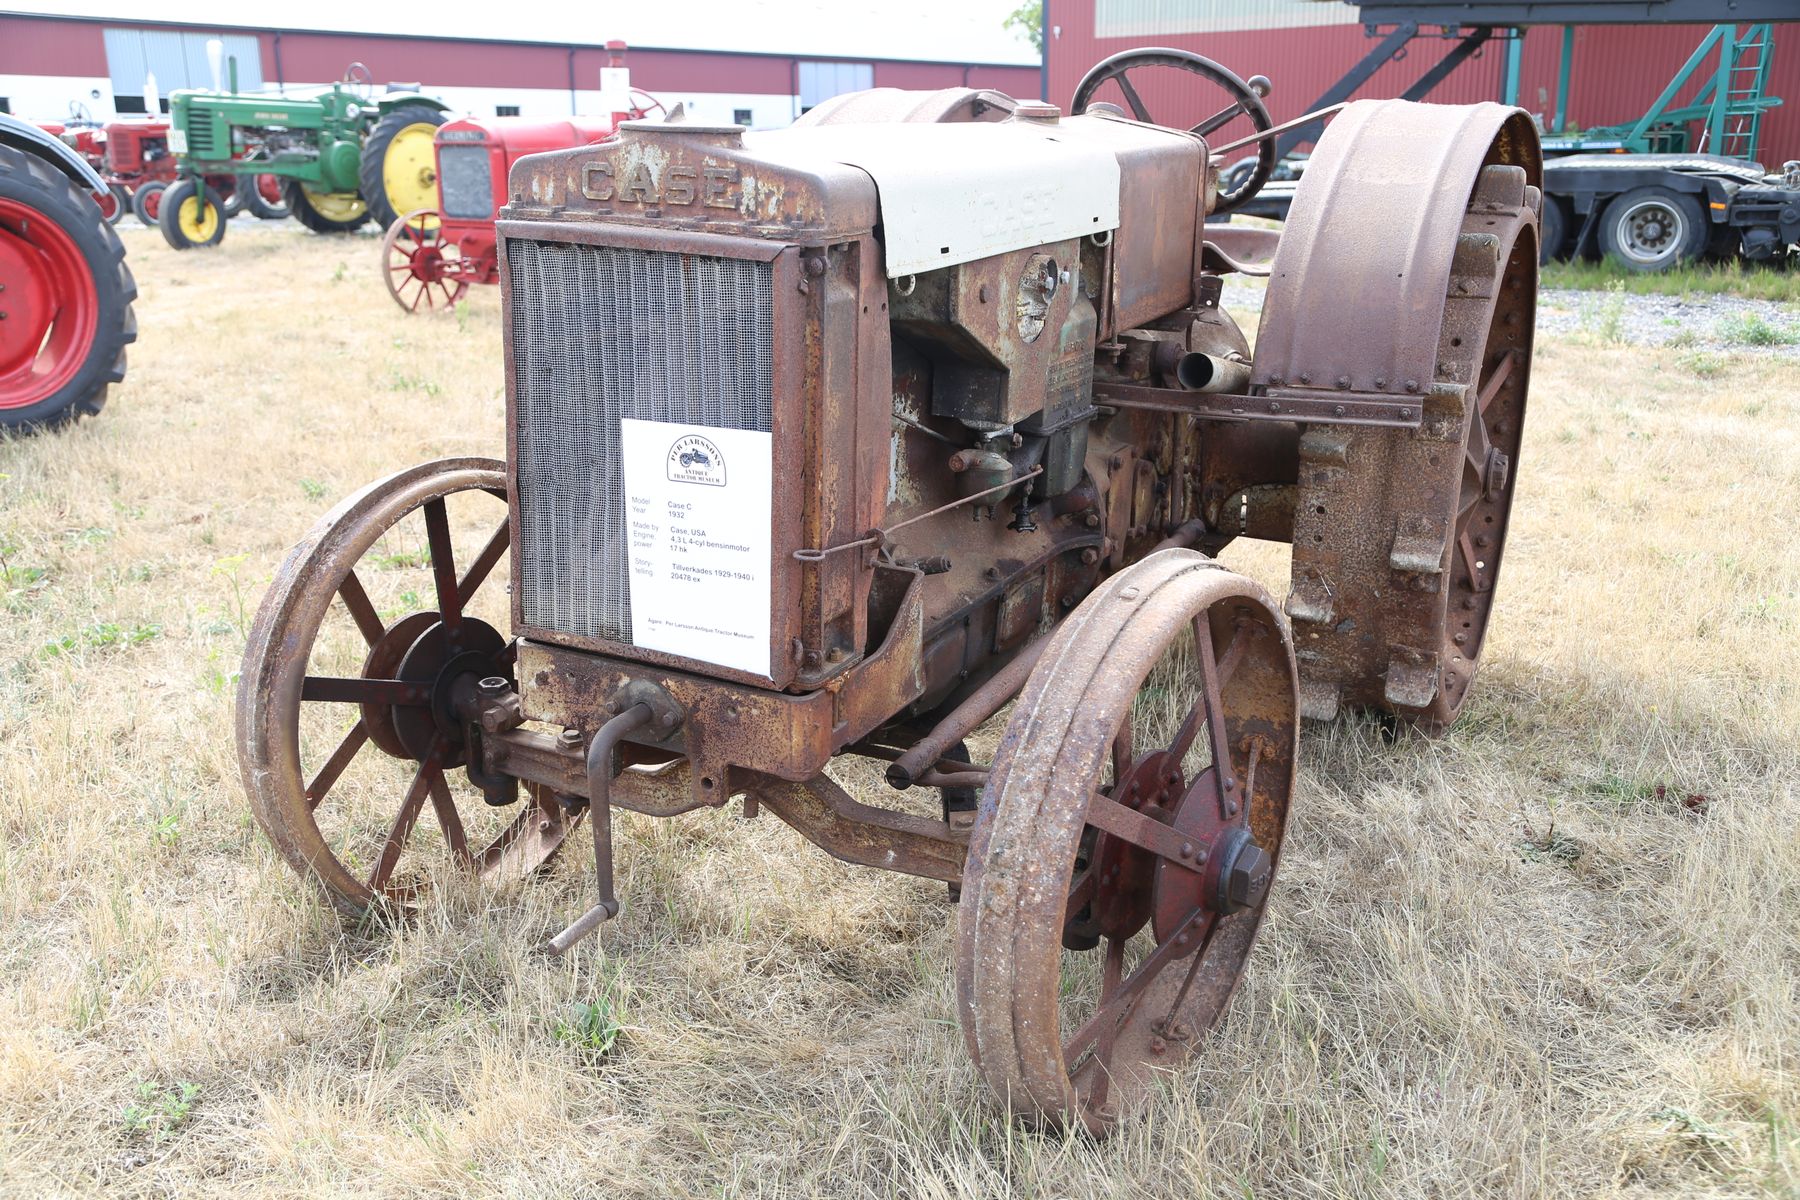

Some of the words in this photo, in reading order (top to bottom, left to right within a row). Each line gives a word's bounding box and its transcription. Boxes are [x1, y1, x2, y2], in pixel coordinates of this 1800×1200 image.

[581, 160, 742, 209] CASE
[671, 444, 683, 462] PER
[684, 438, 720, 466] LARSSONS
[674, 473, 697, 481] TRACTOR
[698, 476, 720, 484] MUSEUM
[632, 506, 646, 514] Year
[667, 501, 685, 510] Case
[668, 510, 685, 519] 1932
[633, 520, 650, 530] Made
[651, 523, 659, 532] by
[691, 528, 707, 537] USA
[633, 540, 653, 549] power
[670, 544, 678, 552] 17
[688, 538, 705, 548] 4-cyl
[706, 540, 750, 552] bensinmotor
[670, 572, 692, 582] 20478
[692, 575, 701, 583] ex
[672, 563, 713, 576] Tillverkades
[714, 569, 751, 581] 1929-1940
[714, 628, 733, 636] Tractor
[733, 631, 755, 640] Museum
